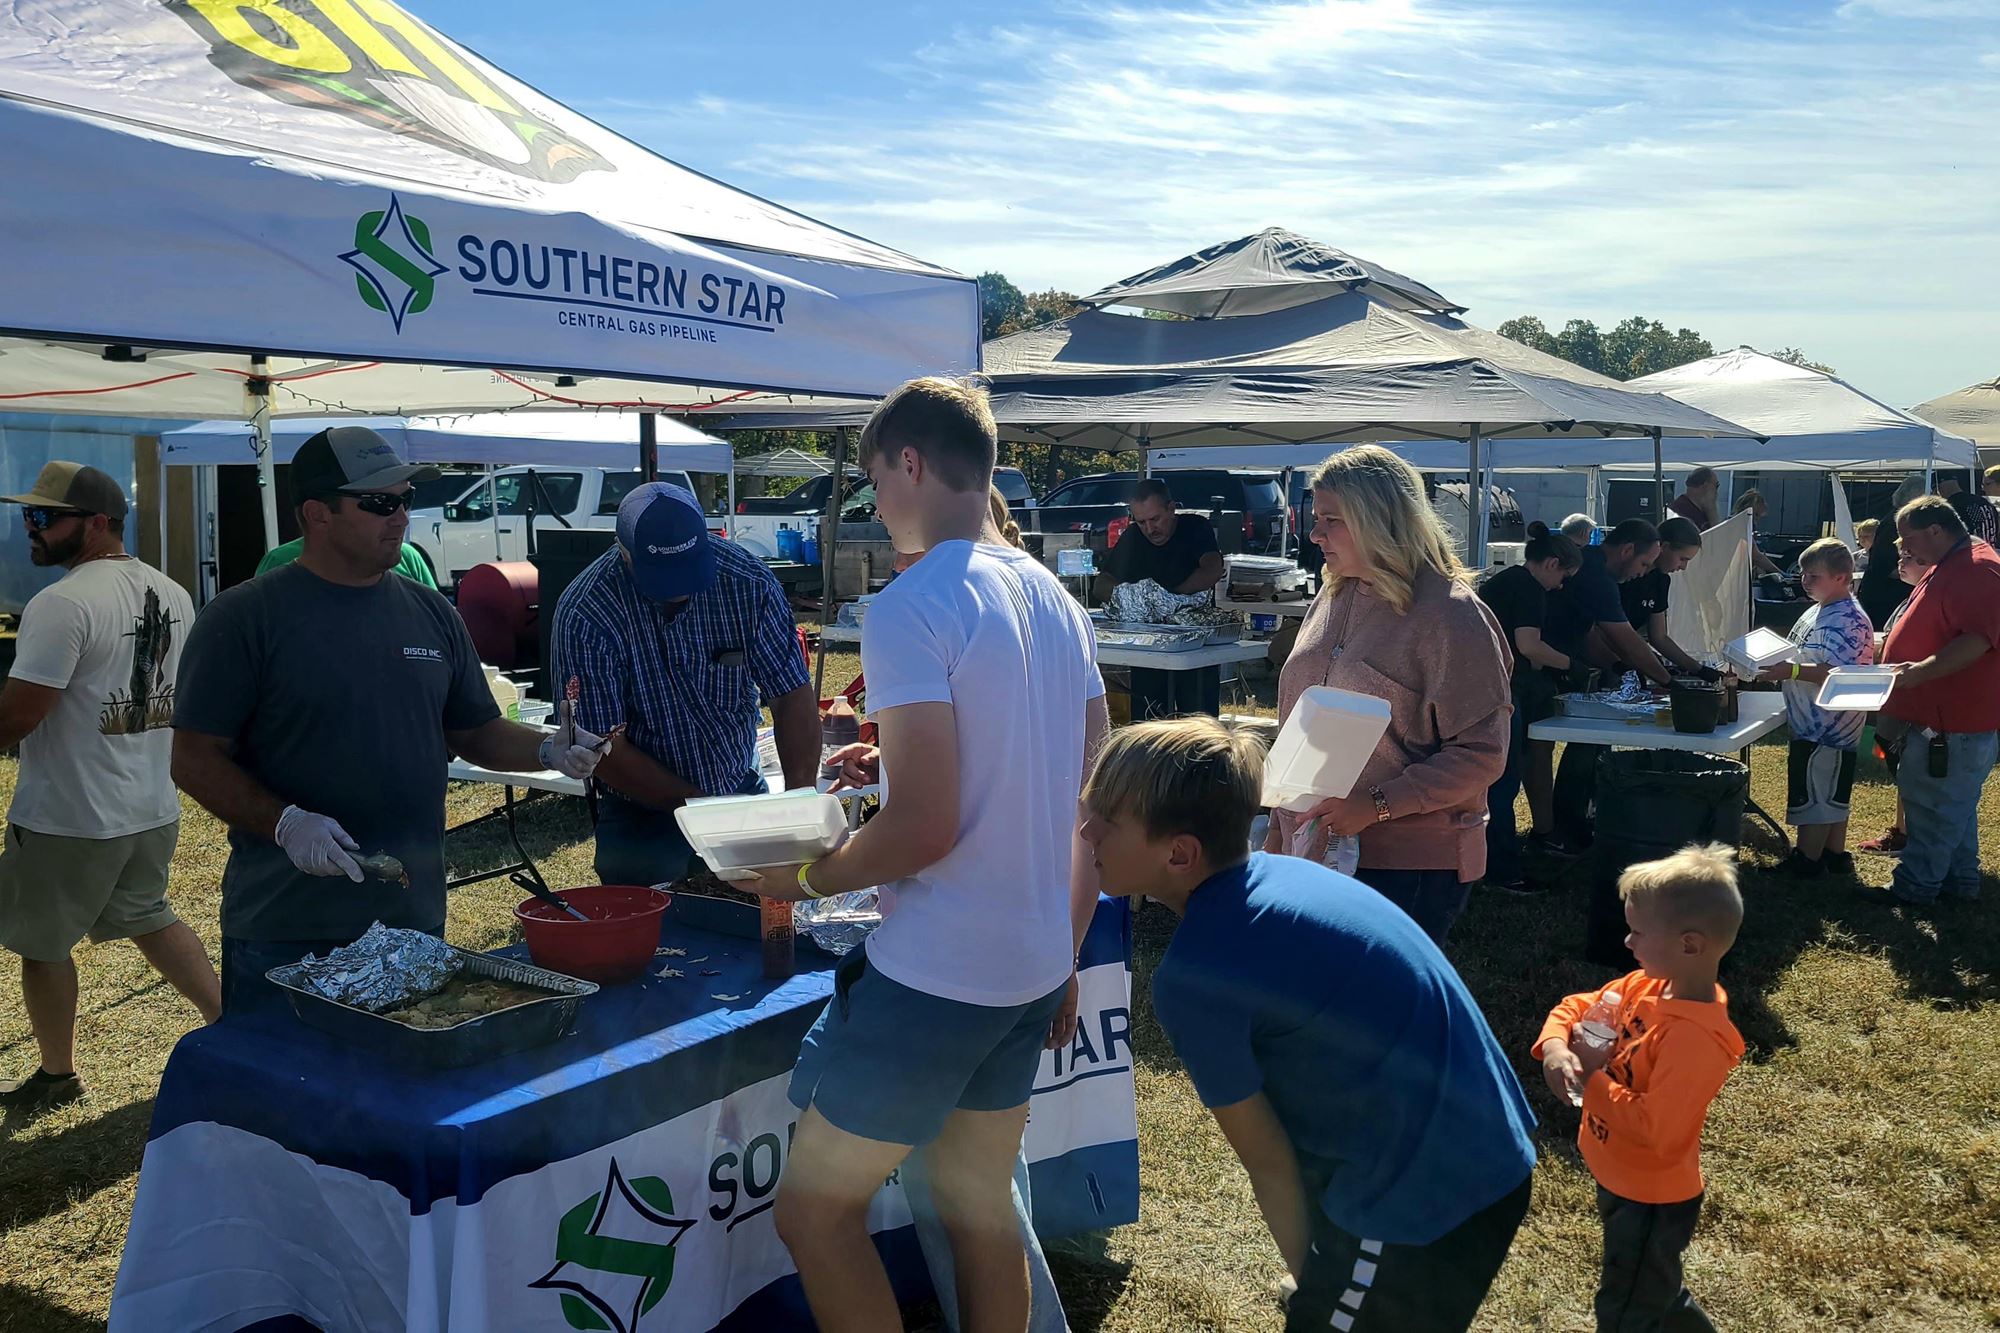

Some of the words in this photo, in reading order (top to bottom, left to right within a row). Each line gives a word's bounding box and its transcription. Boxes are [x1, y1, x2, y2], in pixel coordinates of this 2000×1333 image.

[457, 234, 687, 309] SOUTHERN
[697, 273, 786, 324] STAR
[558, 310, 626, 332] CENTRAL
[628, 319, 656, 336] GAS
[660, 323, 717, 343] PIPELINE
[403, 647, 428, 656] DISCO
